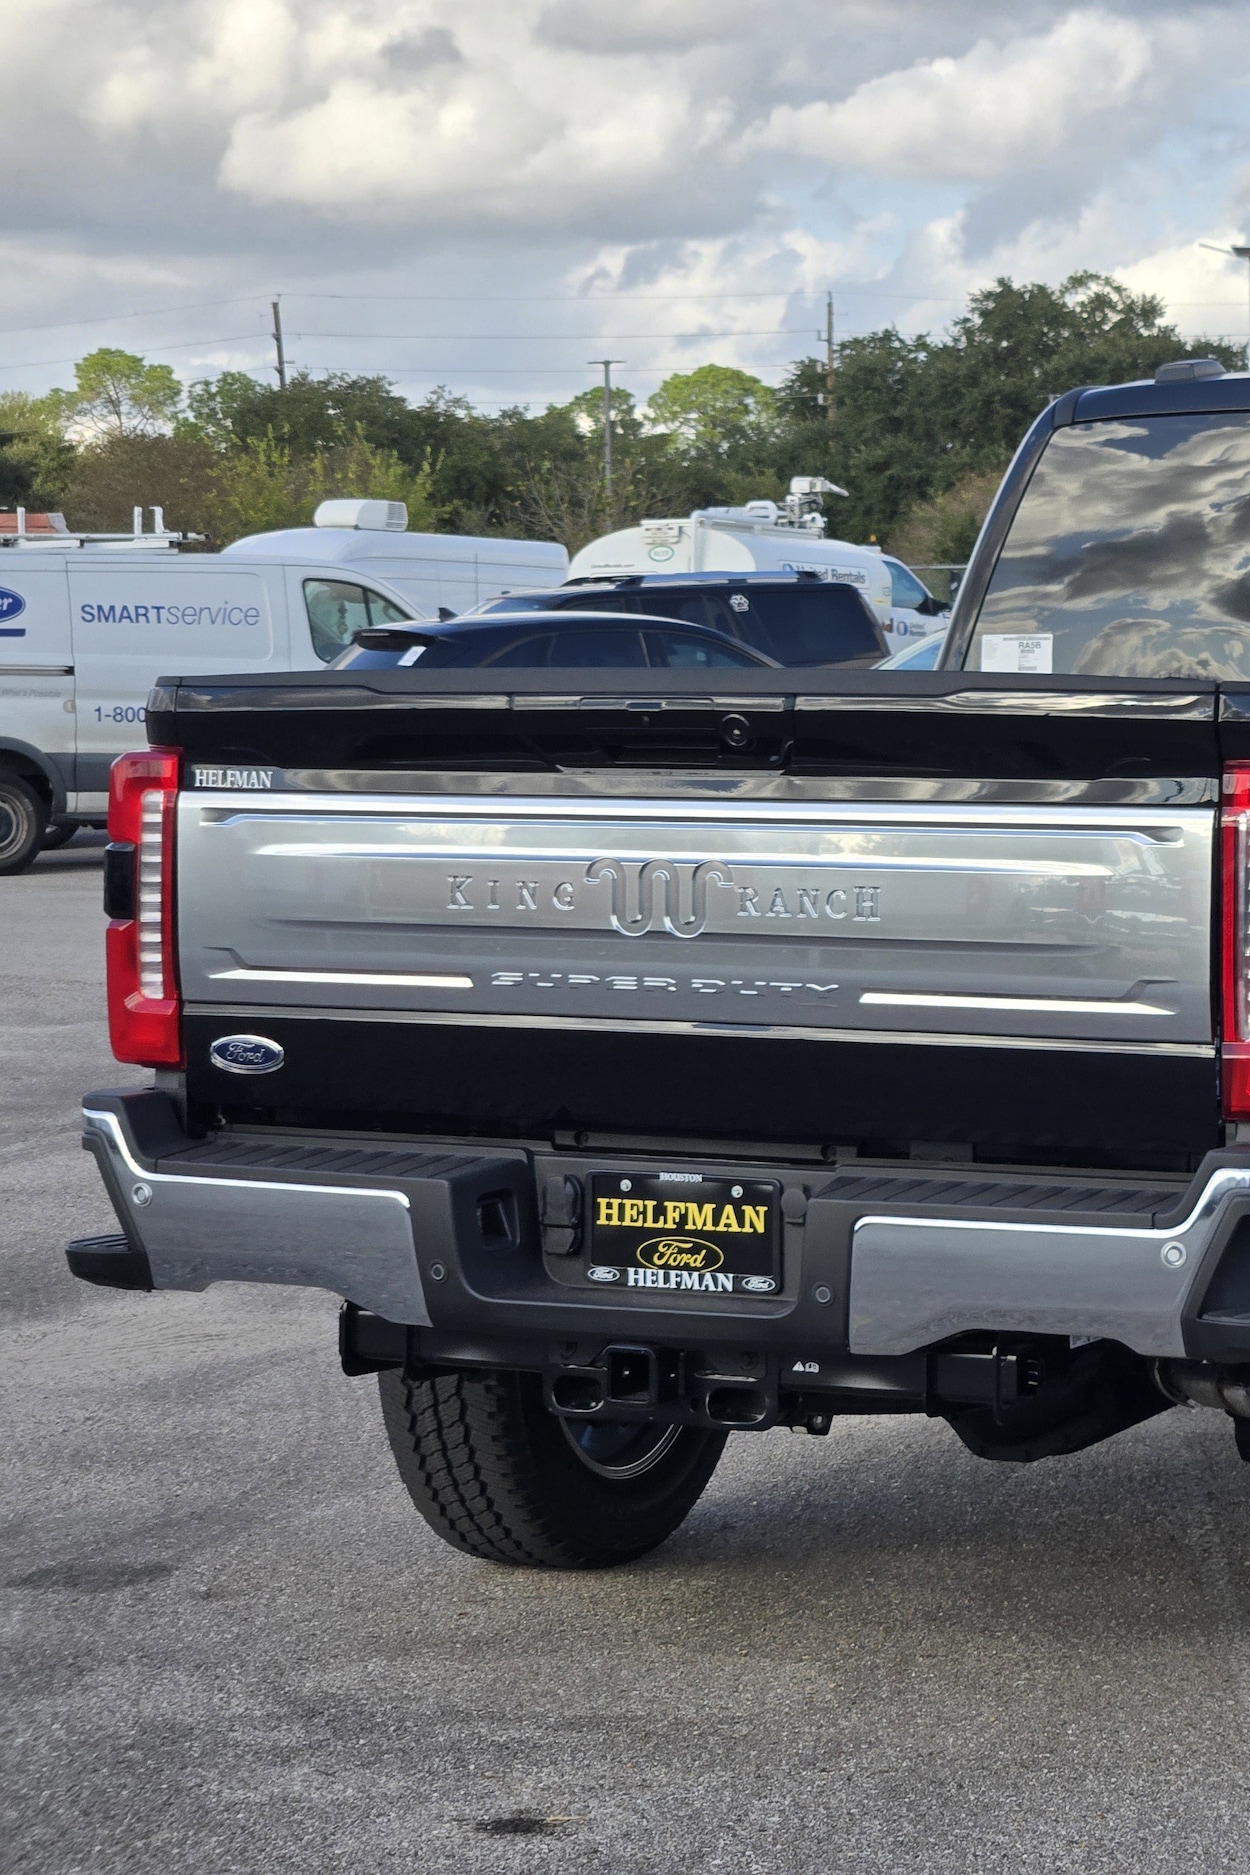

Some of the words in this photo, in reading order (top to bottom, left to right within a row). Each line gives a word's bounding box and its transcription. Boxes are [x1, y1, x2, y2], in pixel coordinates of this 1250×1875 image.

[831, 568, 866, 584] Rentals
[80, 601, 260, 626] SMARTservice
[194, 769, 273, 789] HELFMAN
[446, 875, 575, 911] KING
[736, 886, 881, 922] RANCH
[491, 972, 678, 991] SUPER
[691, 979, 840, 998] DUTY
[226, 1042, 266, 1063] Ford
[660, 1172, 703, 1183] HOUSTON
[596, 1198, 768, 1233] HELFMAN
[653, 1240, 706, 1267] Ford
[627, 1267, 734, 1292] HELFMAN
